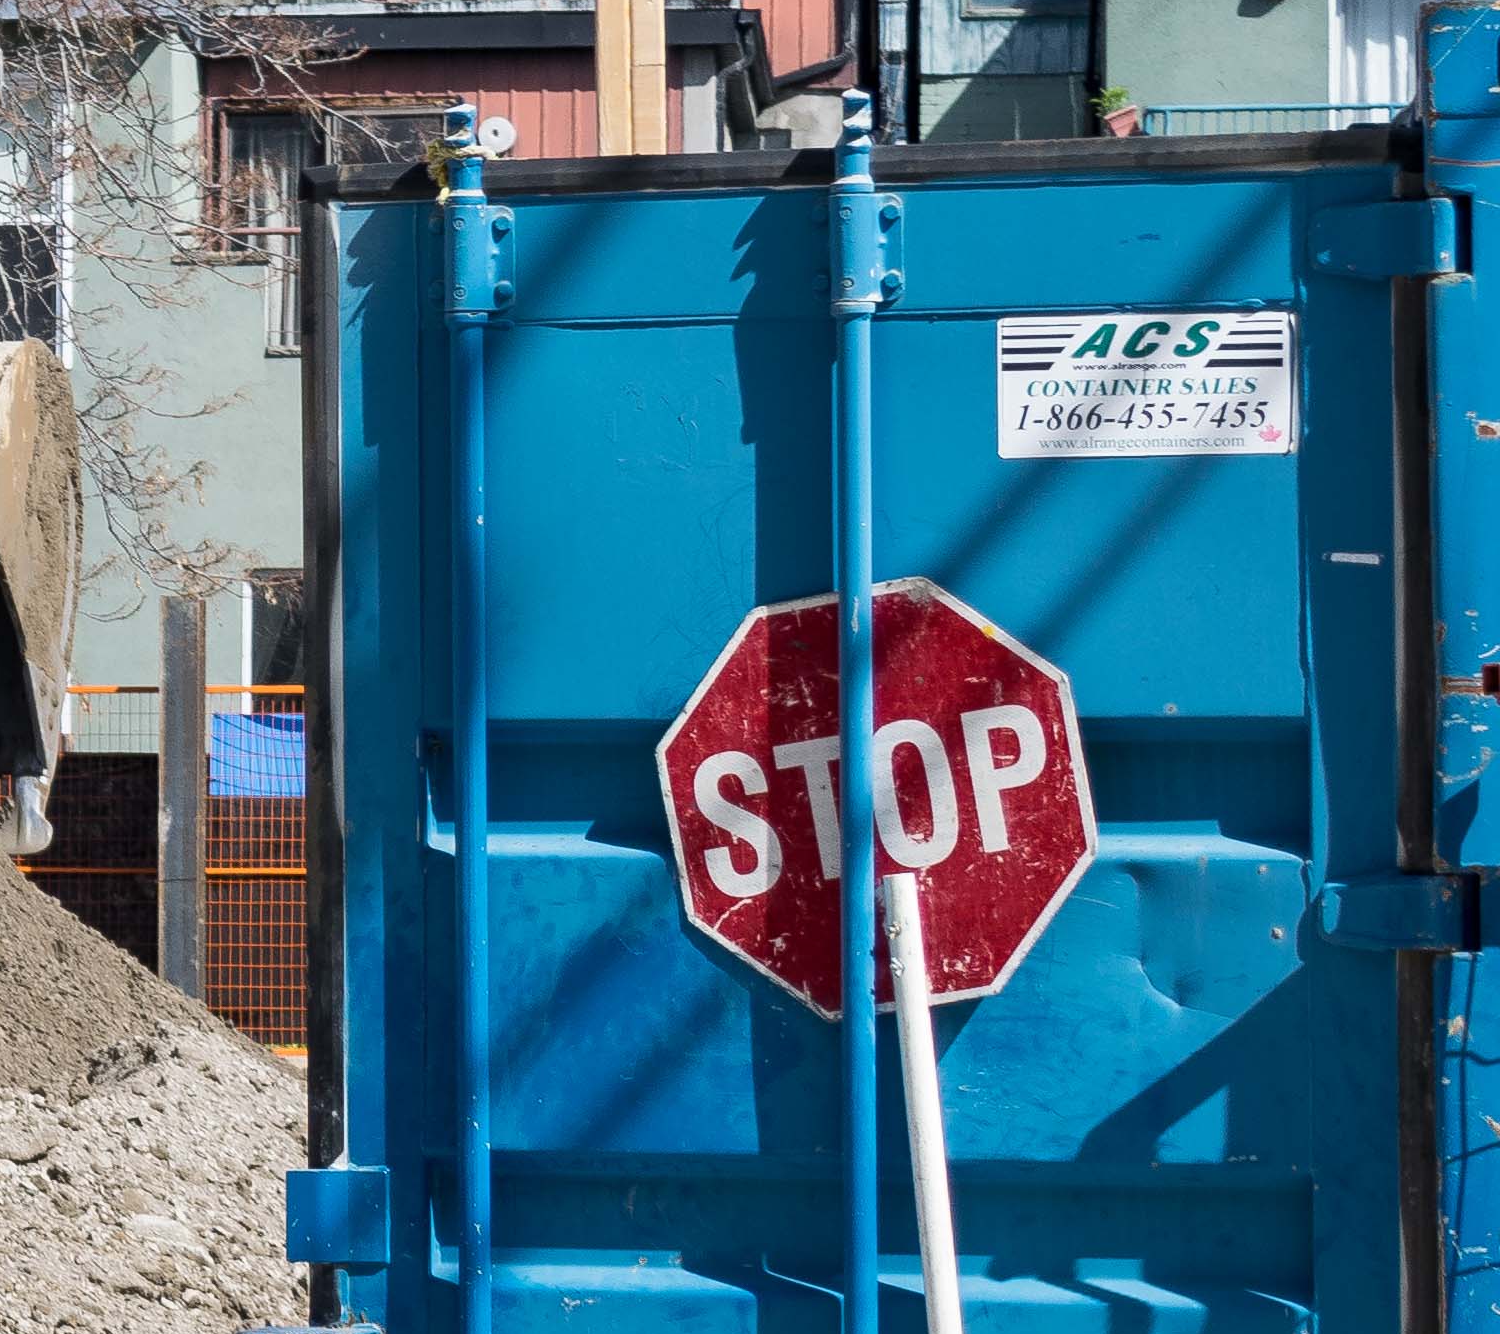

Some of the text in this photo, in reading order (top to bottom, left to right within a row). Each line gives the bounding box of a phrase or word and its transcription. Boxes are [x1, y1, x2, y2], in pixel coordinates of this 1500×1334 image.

[1070, 320, 1221, 359] ACS
[1026, 377, 1258, 398] CONTAINER SALES
[1014, 400, 1269, 432] 1-866-455-7455
[1038, 434, 1246, 451] www.alrangecontainers.com
[693, 704, 1048, 899] STOP
